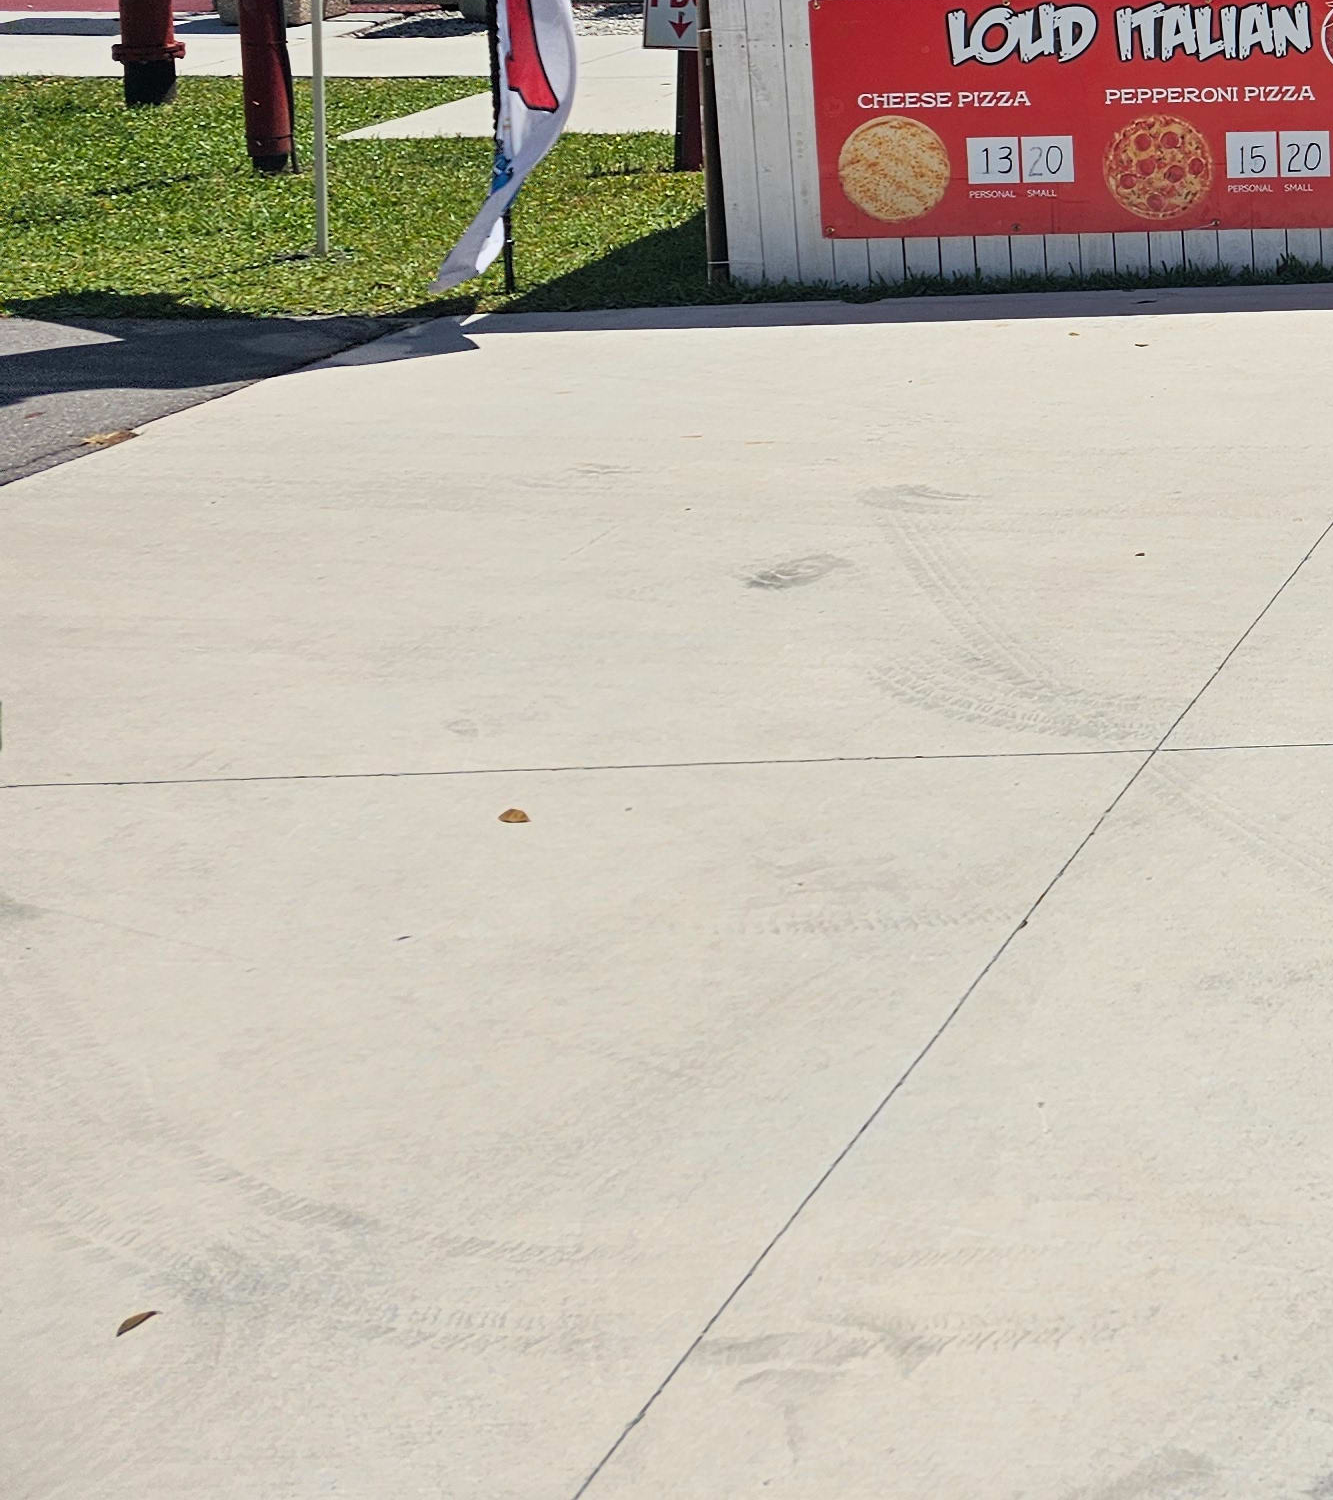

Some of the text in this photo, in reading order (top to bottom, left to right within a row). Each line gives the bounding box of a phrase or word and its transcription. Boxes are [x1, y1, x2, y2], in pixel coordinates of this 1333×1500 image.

[946, 2, 1312, 66] LOUD ITALIAN
[857, 91, 1031, 109] CHEESE PIZZA
[1105, 86, 1315, 104] PEPPERONI PIZZA
[976, 146, 1063, 176] 13 20
[1239, 143, 1322, 174] 15 20
[969, 189, 1057, 198] PERSONAL SMALL
